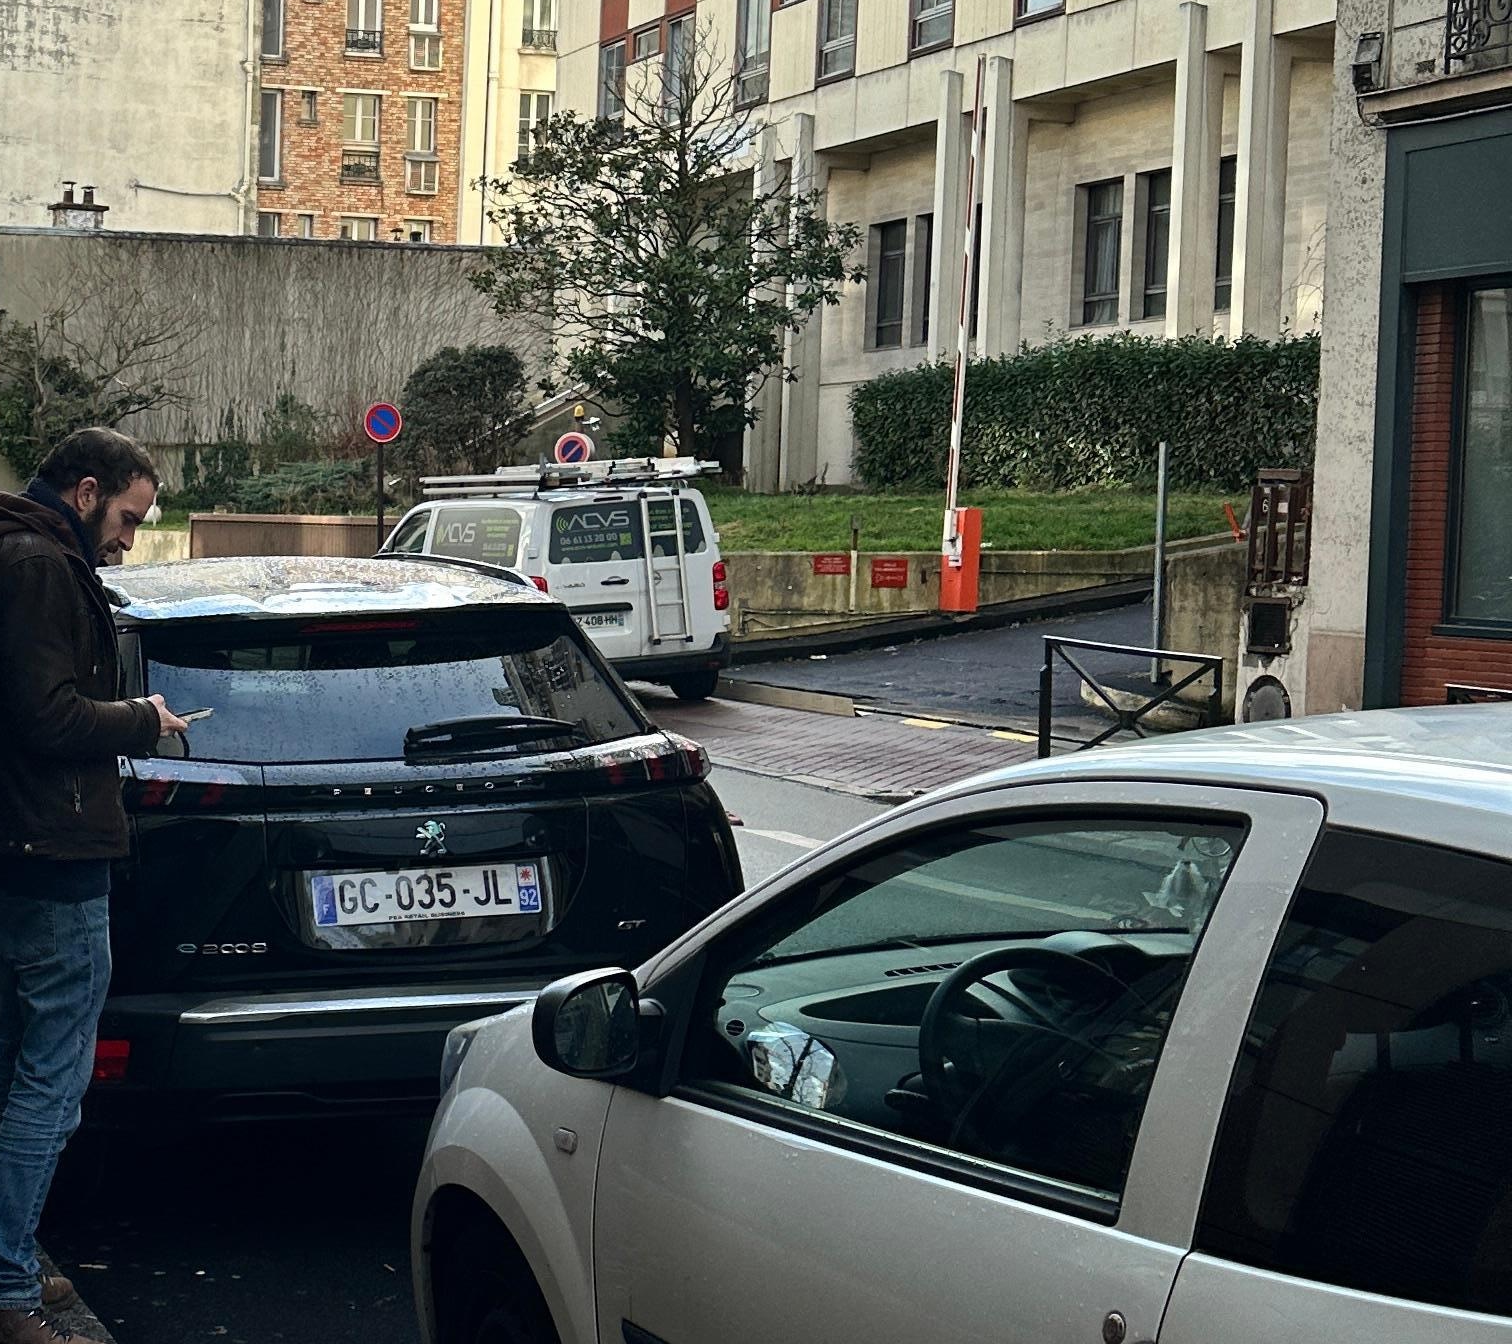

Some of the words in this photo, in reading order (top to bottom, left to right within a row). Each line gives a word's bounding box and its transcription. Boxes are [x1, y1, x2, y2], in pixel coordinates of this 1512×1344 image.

[567, 510, 630, 530] ACVS
[333, 779, 524, 797] PEUGEOT
[338, 869, 513, 915] GC-035-JL
[519, 887, 538, 907] 92
